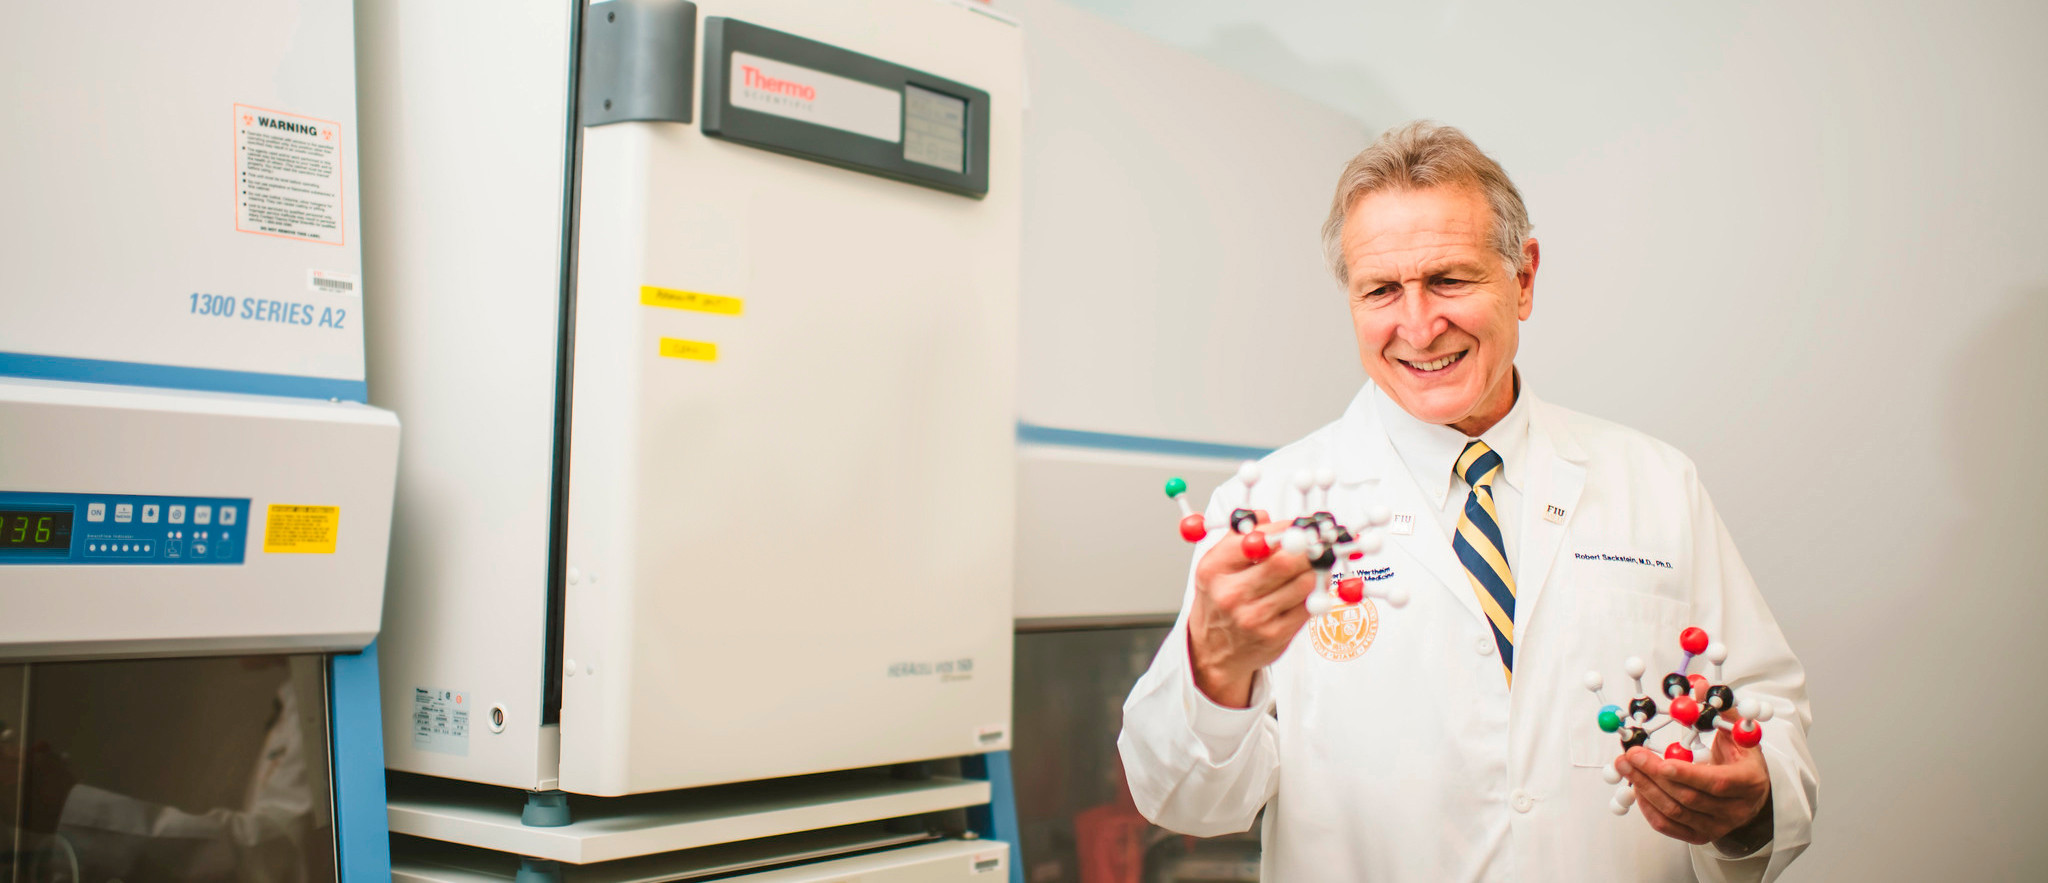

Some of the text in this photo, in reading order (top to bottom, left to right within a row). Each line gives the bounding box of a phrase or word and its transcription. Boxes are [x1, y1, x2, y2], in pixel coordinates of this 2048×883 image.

[741, 64, 816, 102] Thermo
[743, 89, 814, 112] SCIENTIFIC
[258, 116, 318, 136] WARNING
[189, 292, 347, 329] 1300 SERIES A2
[1394, 514, 1412, 523] FIU
[1547, 504, 1565, 517] FIU
[0, 516, 53, 543] 36
[1574, 552, 1601, 561] Robert
[1356, 566, 1391, 576] Wertheim
[1364, 572, 1395, 581] Medicine
